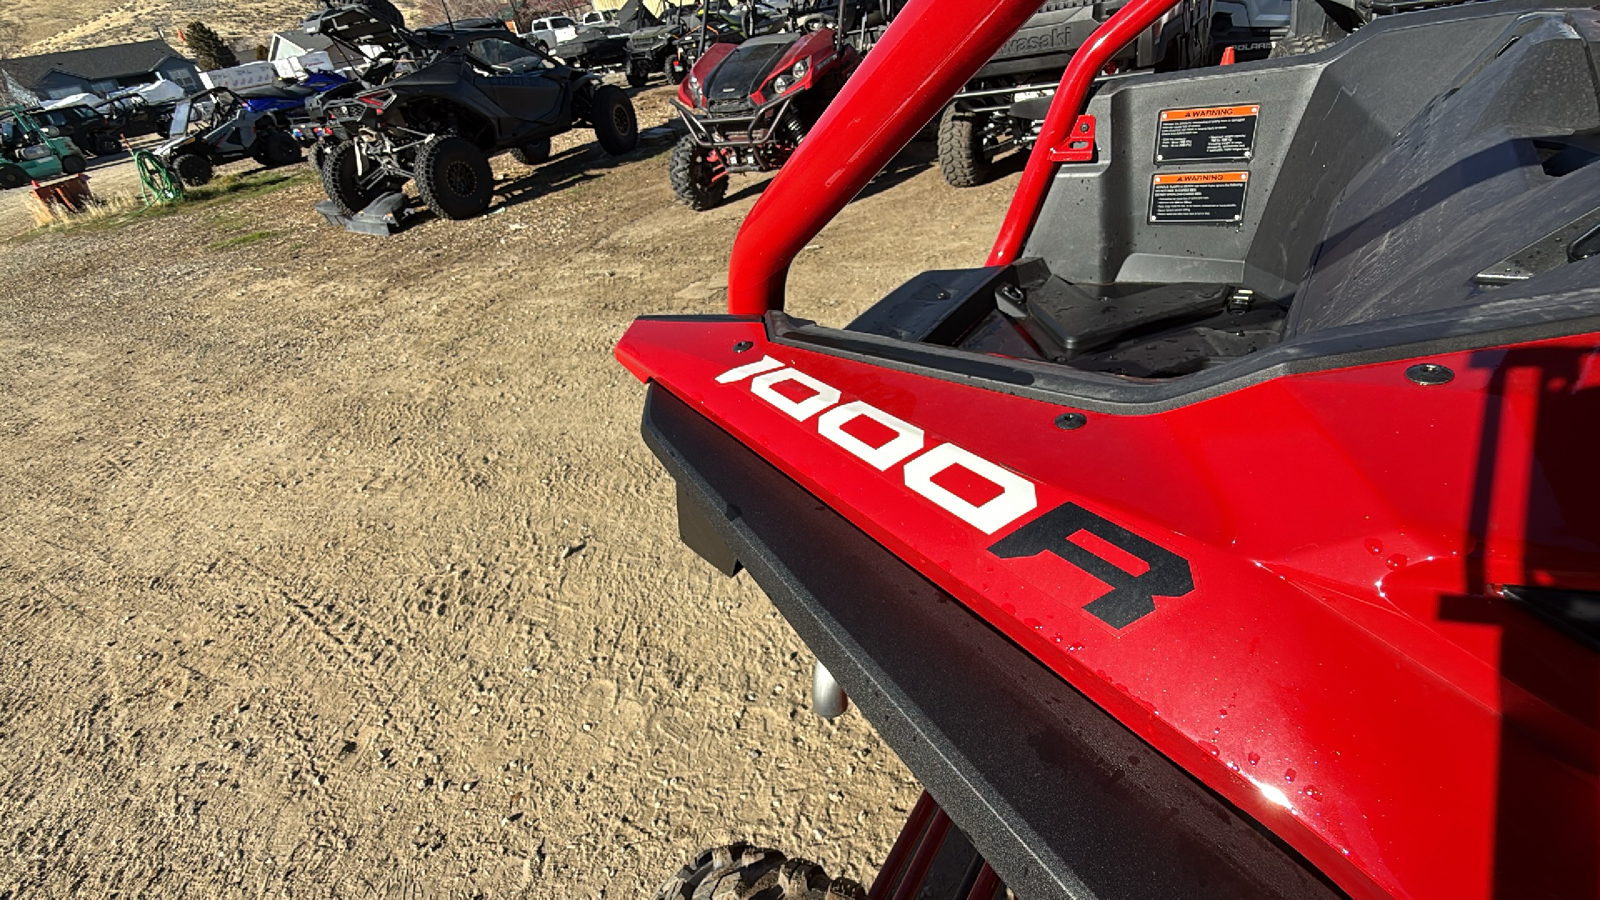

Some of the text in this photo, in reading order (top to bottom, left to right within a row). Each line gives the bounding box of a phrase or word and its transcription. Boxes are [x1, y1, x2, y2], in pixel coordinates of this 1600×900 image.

[998, 26, 1072, 54] wasaki
[1193, 108, 1233, 117] WARNING
[1184, 174, 1224, 182] WARNING
[715, 355, 1195, 630] 1000R
